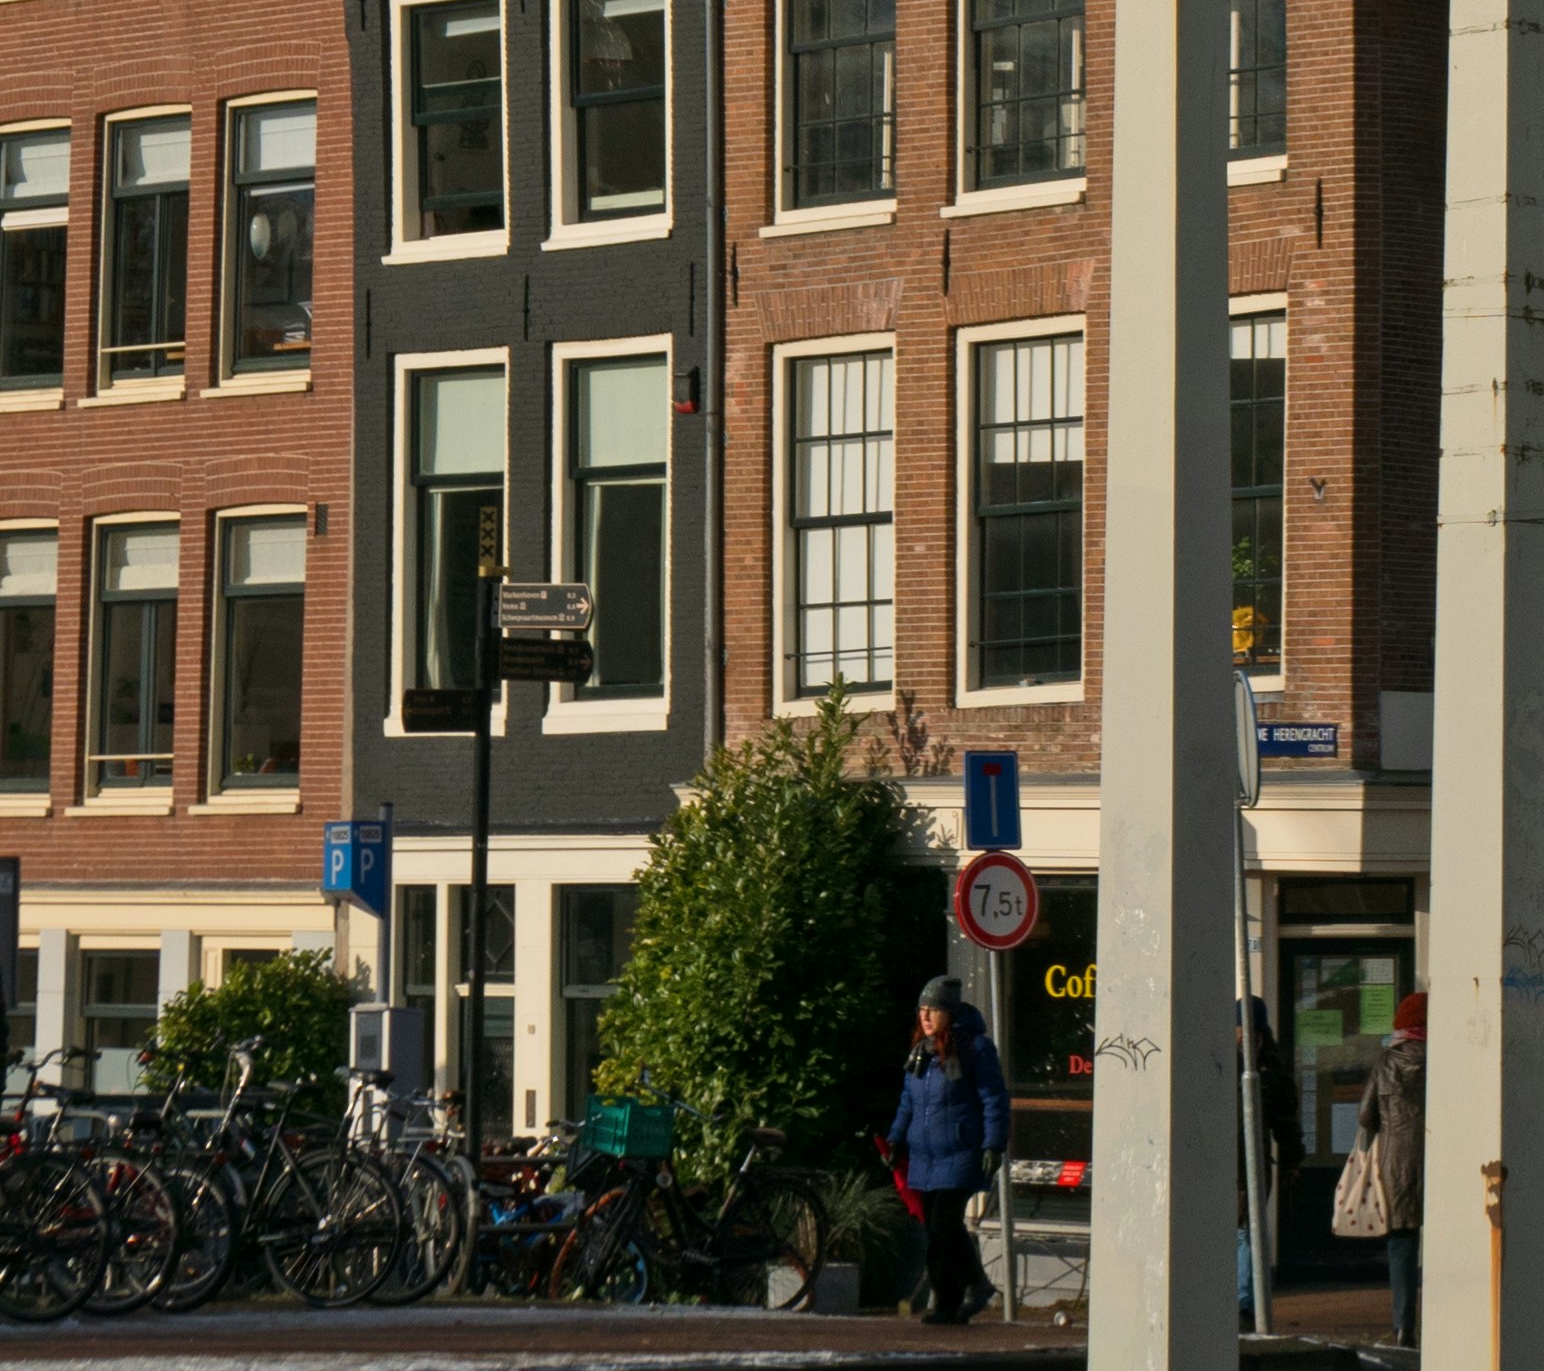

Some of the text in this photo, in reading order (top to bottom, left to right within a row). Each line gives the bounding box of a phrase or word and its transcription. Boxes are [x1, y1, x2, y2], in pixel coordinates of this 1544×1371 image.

[1273, 728, 1335, 741] HERENGRACHT
[331, 849, 344, 885] P
[1069, 1055, 1093, 1075] De
